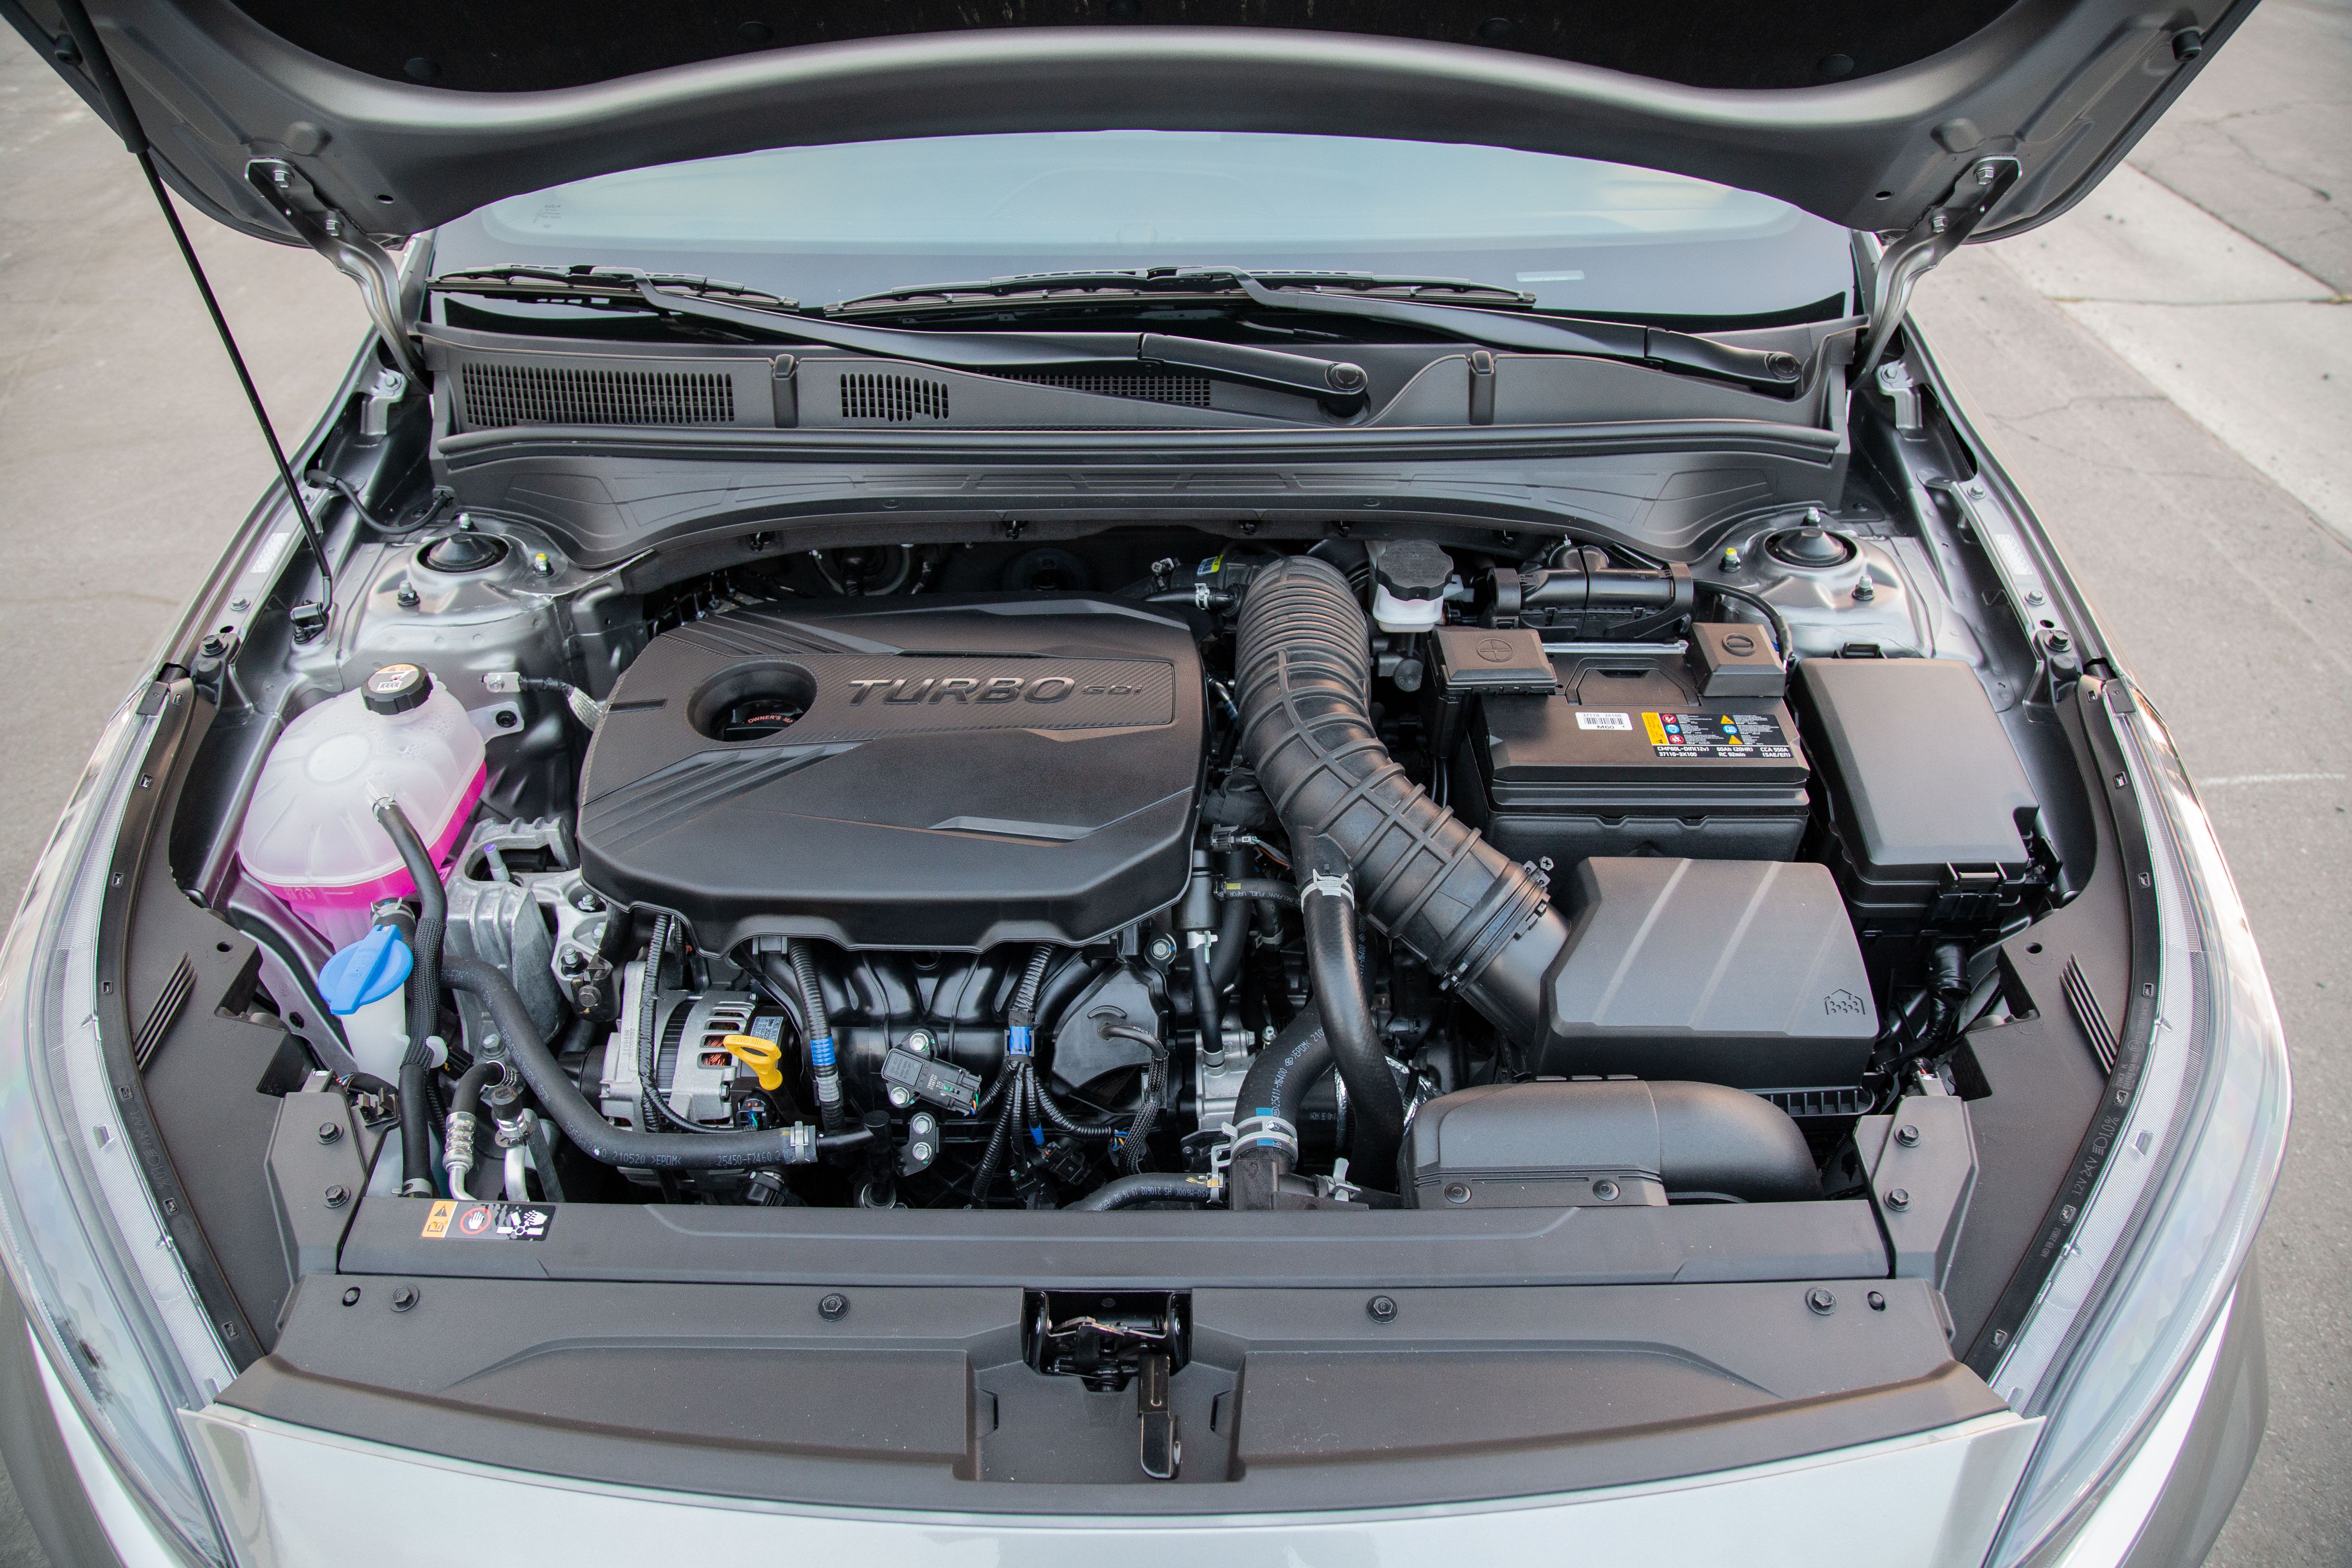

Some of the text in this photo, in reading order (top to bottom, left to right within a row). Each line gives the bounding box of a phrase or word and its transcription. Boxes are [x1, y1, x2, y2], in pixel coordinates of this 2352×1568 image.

[848, 678, 1143, 706] TURBO GDi
[1272, 1066, 1288, 1107] 25411-M6400
[1290, 1041, 1312, 1057] >EPDM<
[1309, 1027, 1325, 1041] 210
[612, 1151, 646, 1164] 210520
[651, 1155, 682, 1166] >EPDM<
[718, 1151, 772, 1166] 25450-F2460
[2071, 1179, 2088, 1196] 12V
[2099, 1113, 2120, 1140] 1.0%
[1113, 1187, 1137, 1203] 19:16:02
[1141, 1186, 1161, 1195] 210602
[1164, 1187, 1171, 1195] HS
